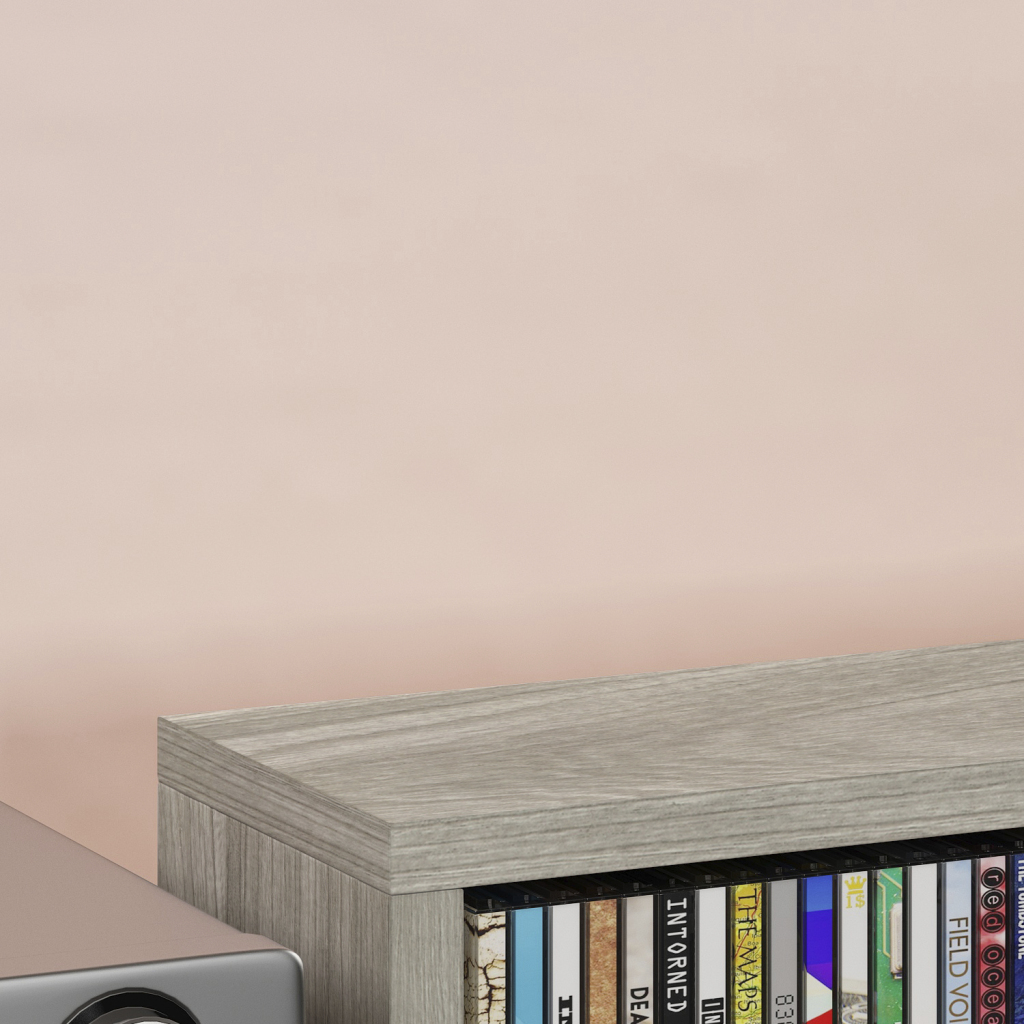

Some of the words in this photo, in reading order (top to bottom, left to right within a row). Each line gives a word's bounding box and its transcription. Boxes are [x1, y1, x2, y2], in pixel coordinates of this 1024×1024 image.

[738, 888, 757, 939] THE
[983, 869, 1003, 932] red
[668, 898, 687, 1013] INTORNED
[737, 946, 757, 1011] MAPS
[949, 917, 969, 977] FIELD
